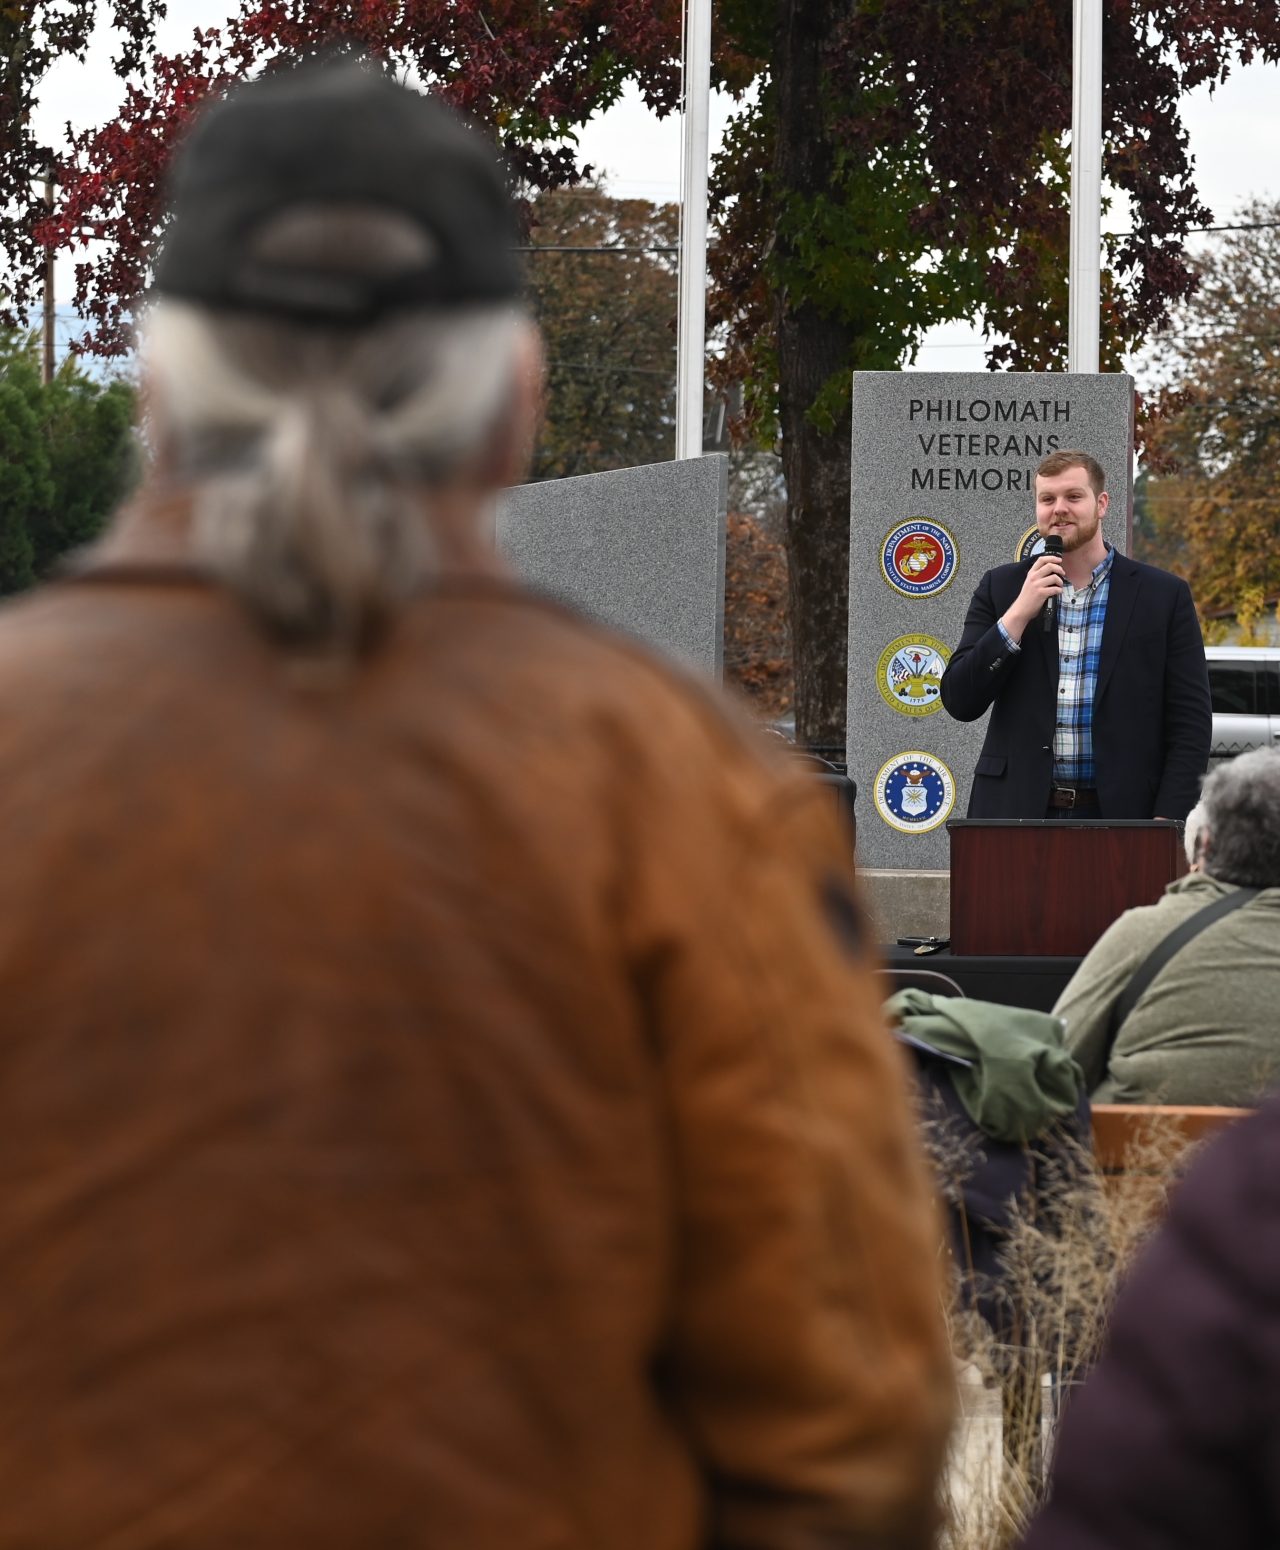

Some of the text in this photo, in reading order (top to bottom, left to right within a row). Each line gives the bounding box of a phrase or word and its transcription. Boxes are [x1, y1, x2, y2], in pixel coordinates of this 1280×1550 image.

[909, 399, 1070, 422] PHILOMATH
[918, 434, 1059, 456] VETERANS
[911, 468, 1031, 491] MEMORI
[886, 524, 921, 557] DEPARTMENT
[940, 536, 952, 556] NAVY
[886, 562, 951, 591] UNITED STATES MARINE CORPS
[880, 637, 914, 671] DEPARTMENT
[877, 759, 899, 804] DEPARTMENT
